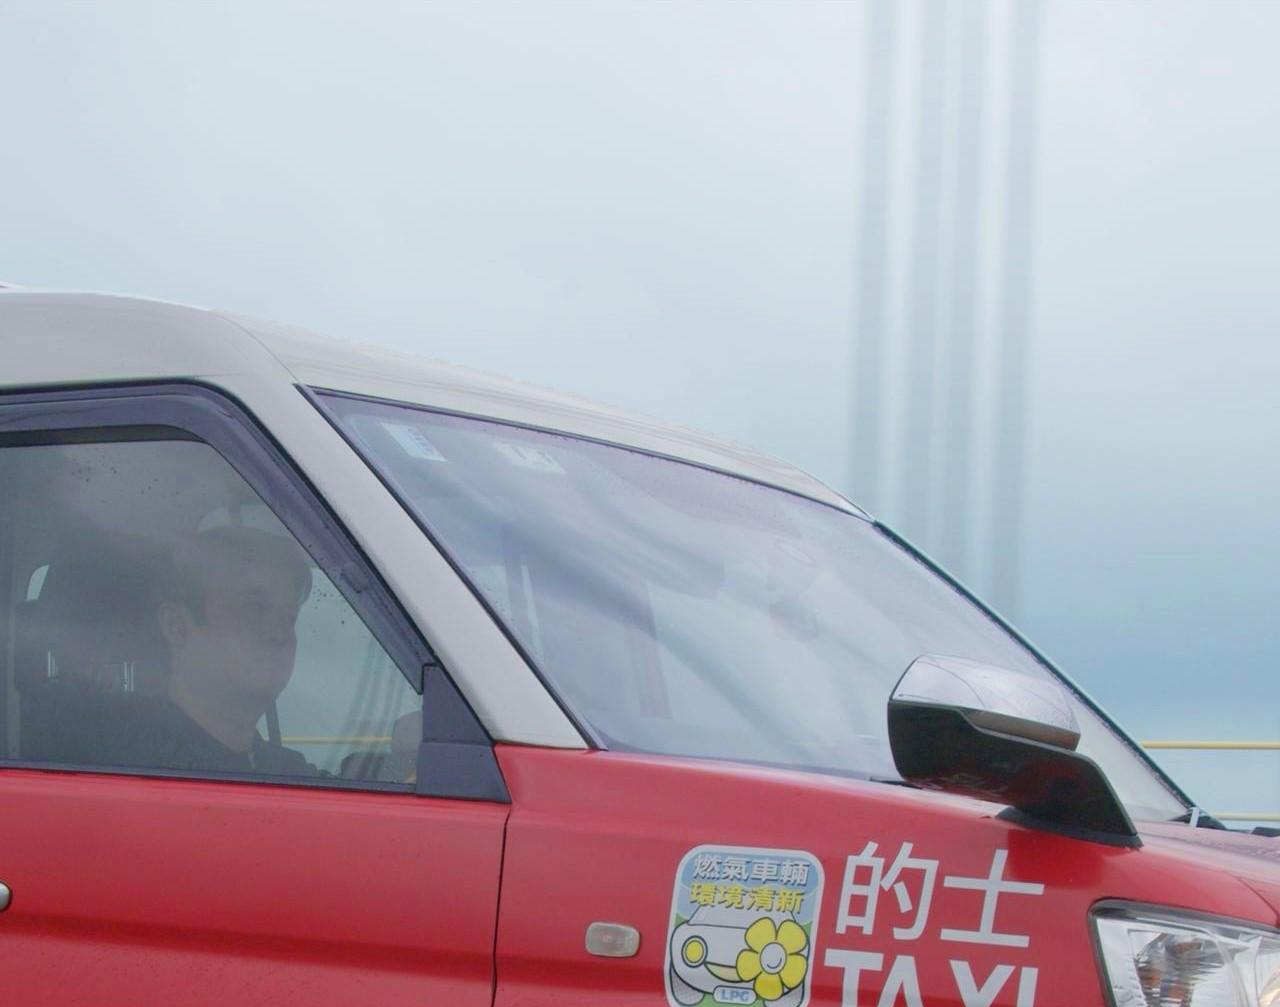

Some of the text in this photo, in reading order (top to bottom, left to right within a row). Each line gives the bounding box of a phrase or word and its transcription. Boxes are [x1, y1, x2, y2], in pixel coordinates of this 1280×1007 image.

[693, 853, 810, 887] 燃氣車輛
[689, 881, 806, 914] 環境清新
[834, 840, 1045, 948] 的士
[719, 988, 750, 1002] LPG
